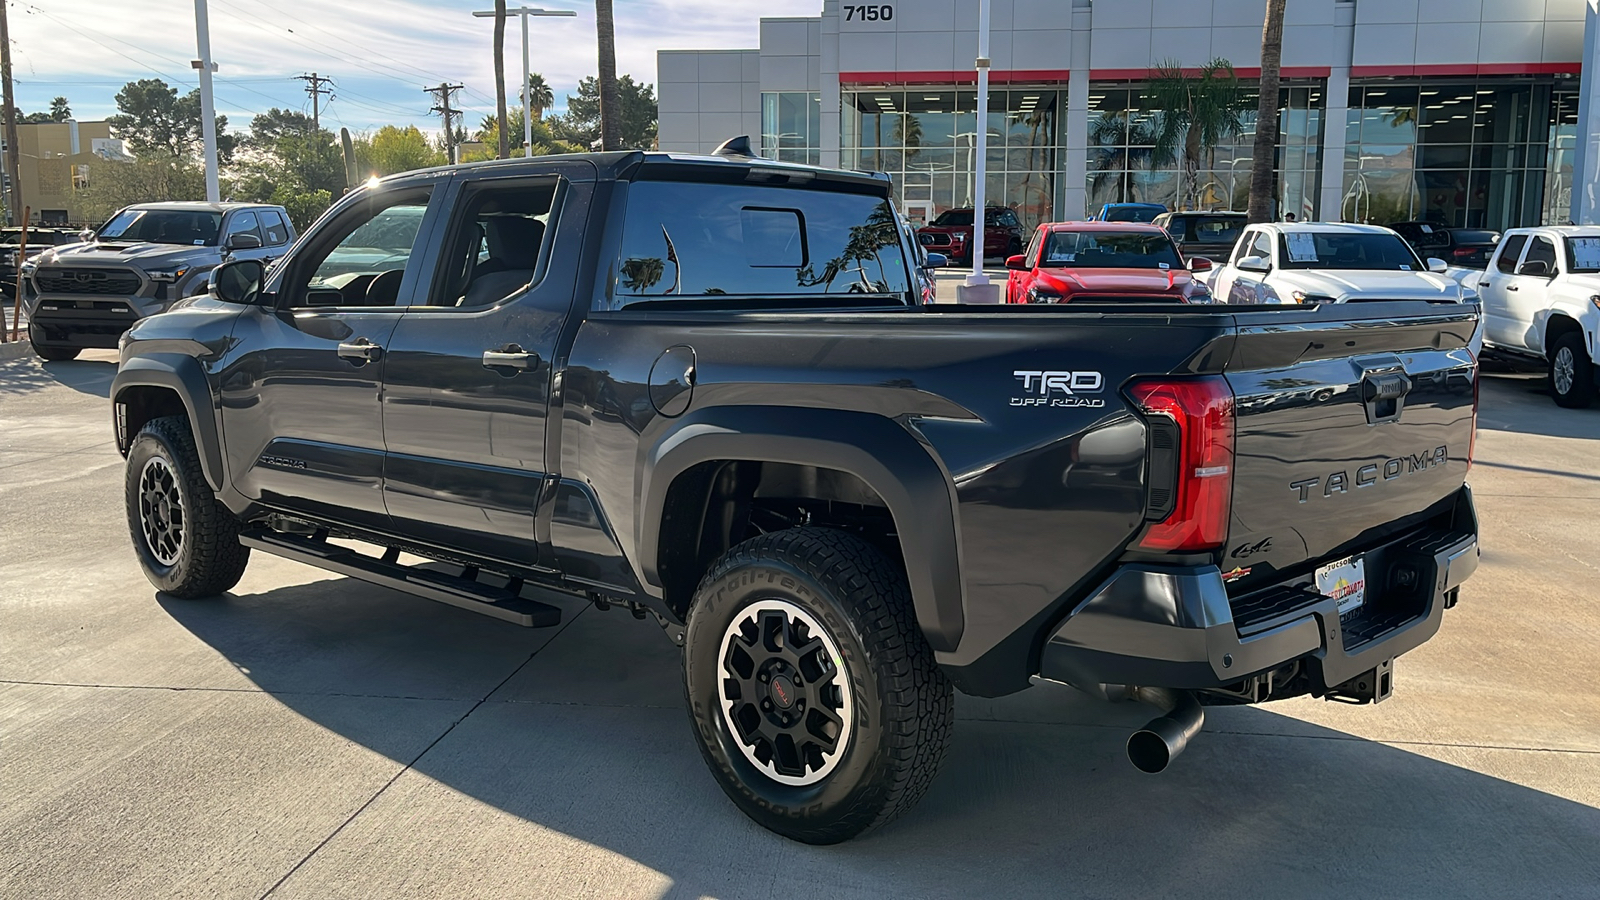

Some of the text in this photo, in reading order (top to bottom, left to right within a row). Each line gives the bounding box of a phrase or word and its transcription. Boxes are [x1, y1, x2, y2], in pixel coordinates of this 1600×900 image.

[843, 5, 893, 21] 7150
[1013, 370, 1103, 395] TRD
[1009, 397, 1106, 408] OFF ROAD
[1289, 445, 1448, 503] TACOMA
[1327, 557, 1353, 571] TUCSON
[1342, 580, 1364, 597] TOYOTA
